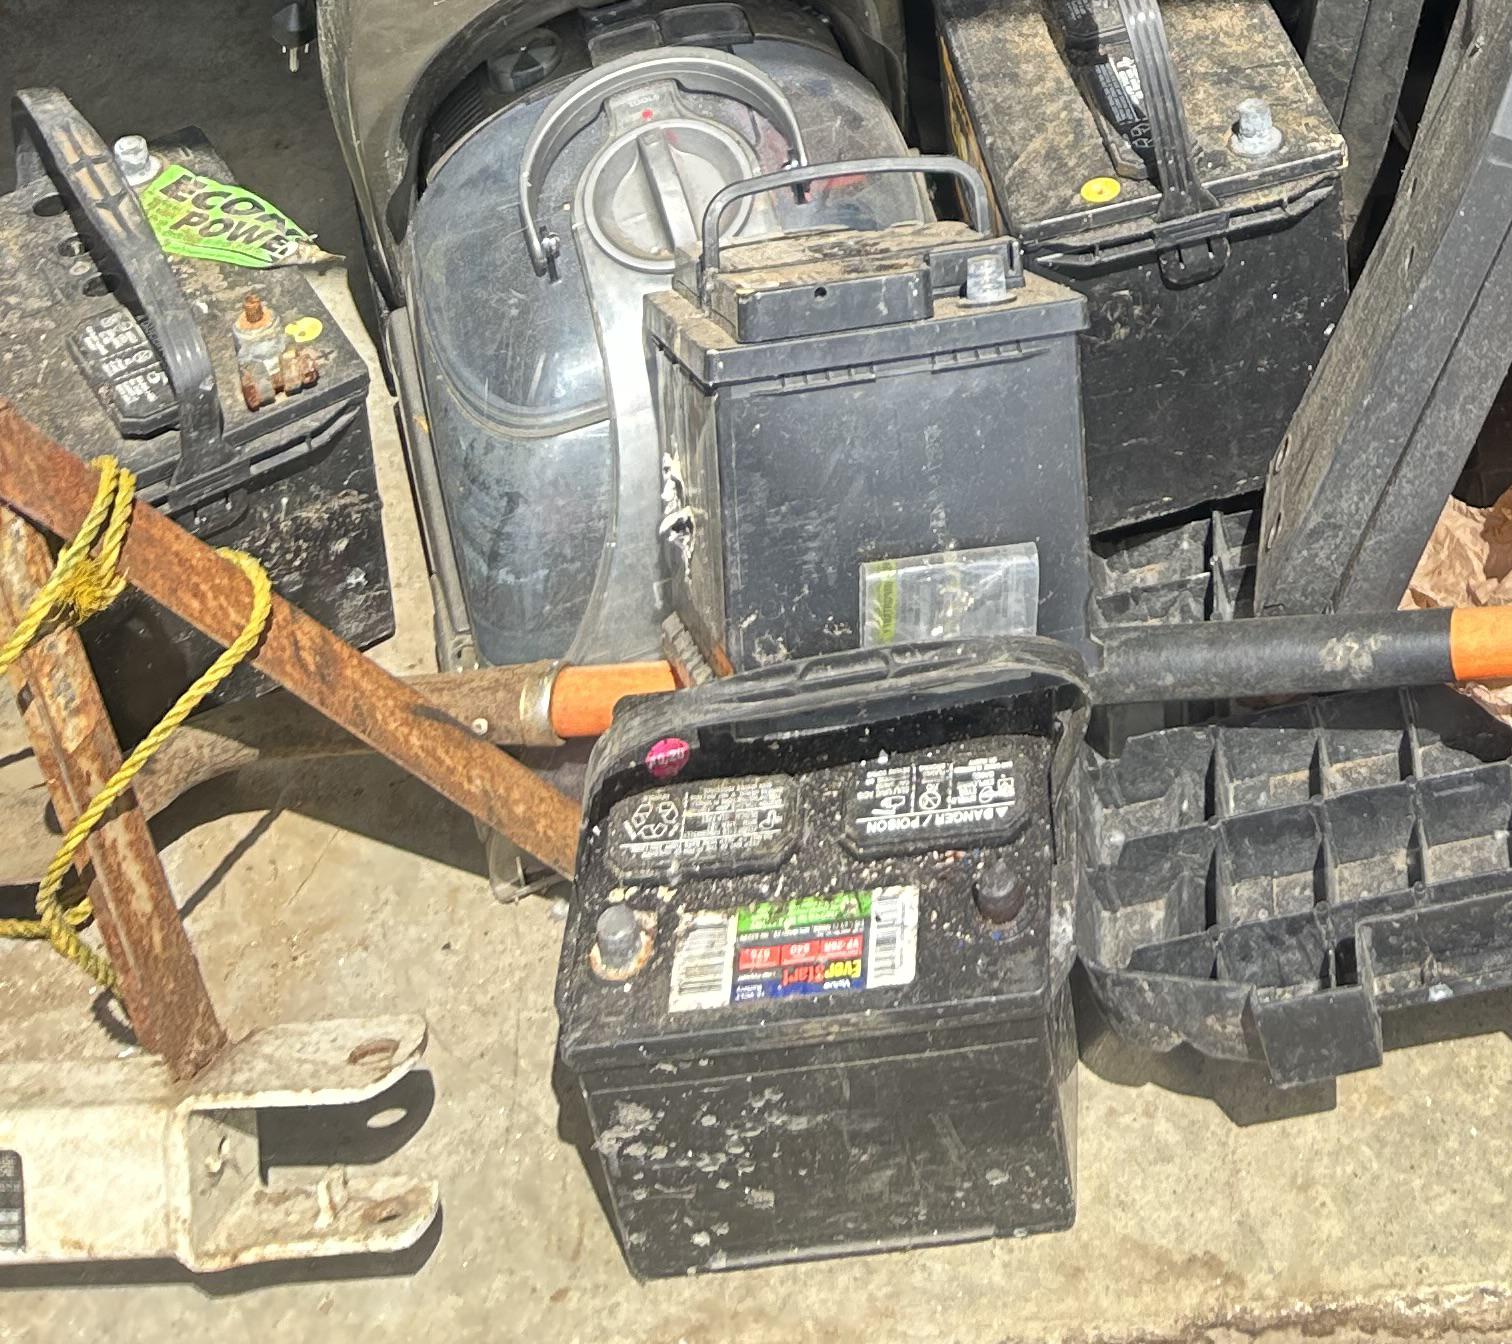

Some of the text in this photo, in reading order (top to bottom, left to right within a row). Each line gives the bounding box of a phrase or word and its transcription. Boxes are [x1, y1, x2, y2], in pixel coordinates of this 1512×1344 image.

[866, 815, 920, 834] POISON
[934, 808, 994, 826] DANGER
[781, 958, 862, 987] EverStart
